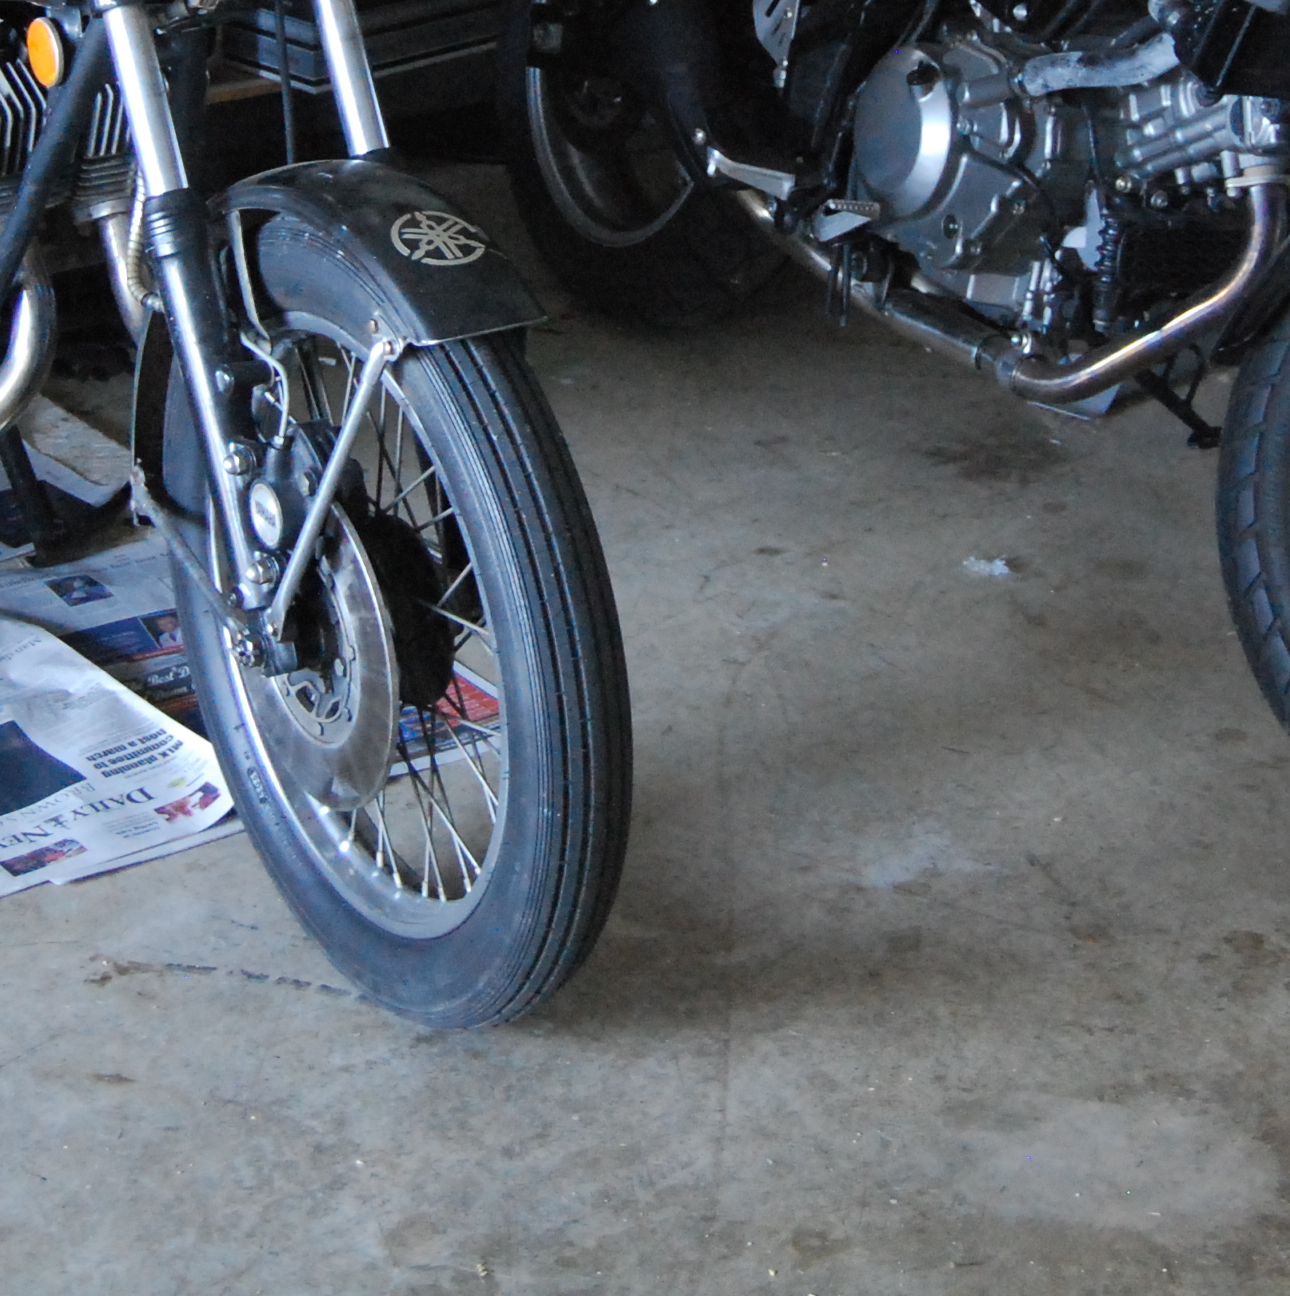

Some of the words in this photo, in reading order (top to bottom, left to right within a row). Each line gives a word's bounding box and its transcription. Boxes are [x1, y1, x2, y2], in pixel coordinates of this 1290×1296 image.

[85, 743, 128, 764] march
[108, 733, 174, 767] committee
[158, 739, 184, 760] MLK
[93, 760, 109, 770] to
[100, 753, 158, 780] planning
[71, 787, 156, 820] DAILY
